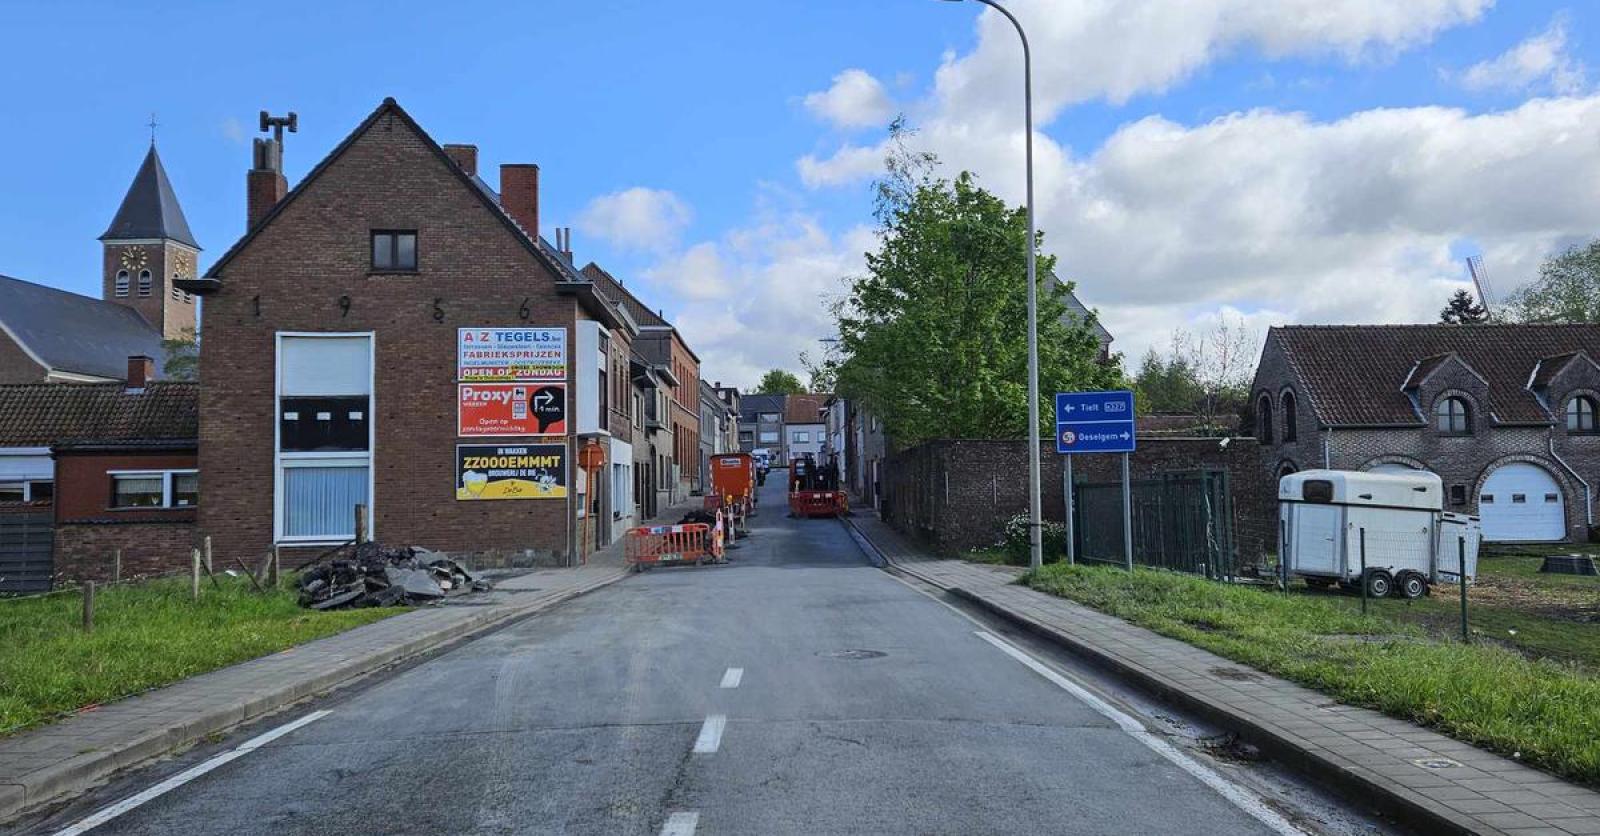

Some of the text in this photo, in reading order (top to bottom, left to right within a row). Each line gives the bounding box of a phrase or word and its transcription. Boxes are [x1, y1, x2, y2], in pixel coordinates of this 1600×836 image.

[463, 368, 493, 376] OPEN
[462, 387, 512, 405] Proxy
[1080, 403, 1099, 411] Tielt
[463, 455, 561, 469] ZZOOOEMMMT
